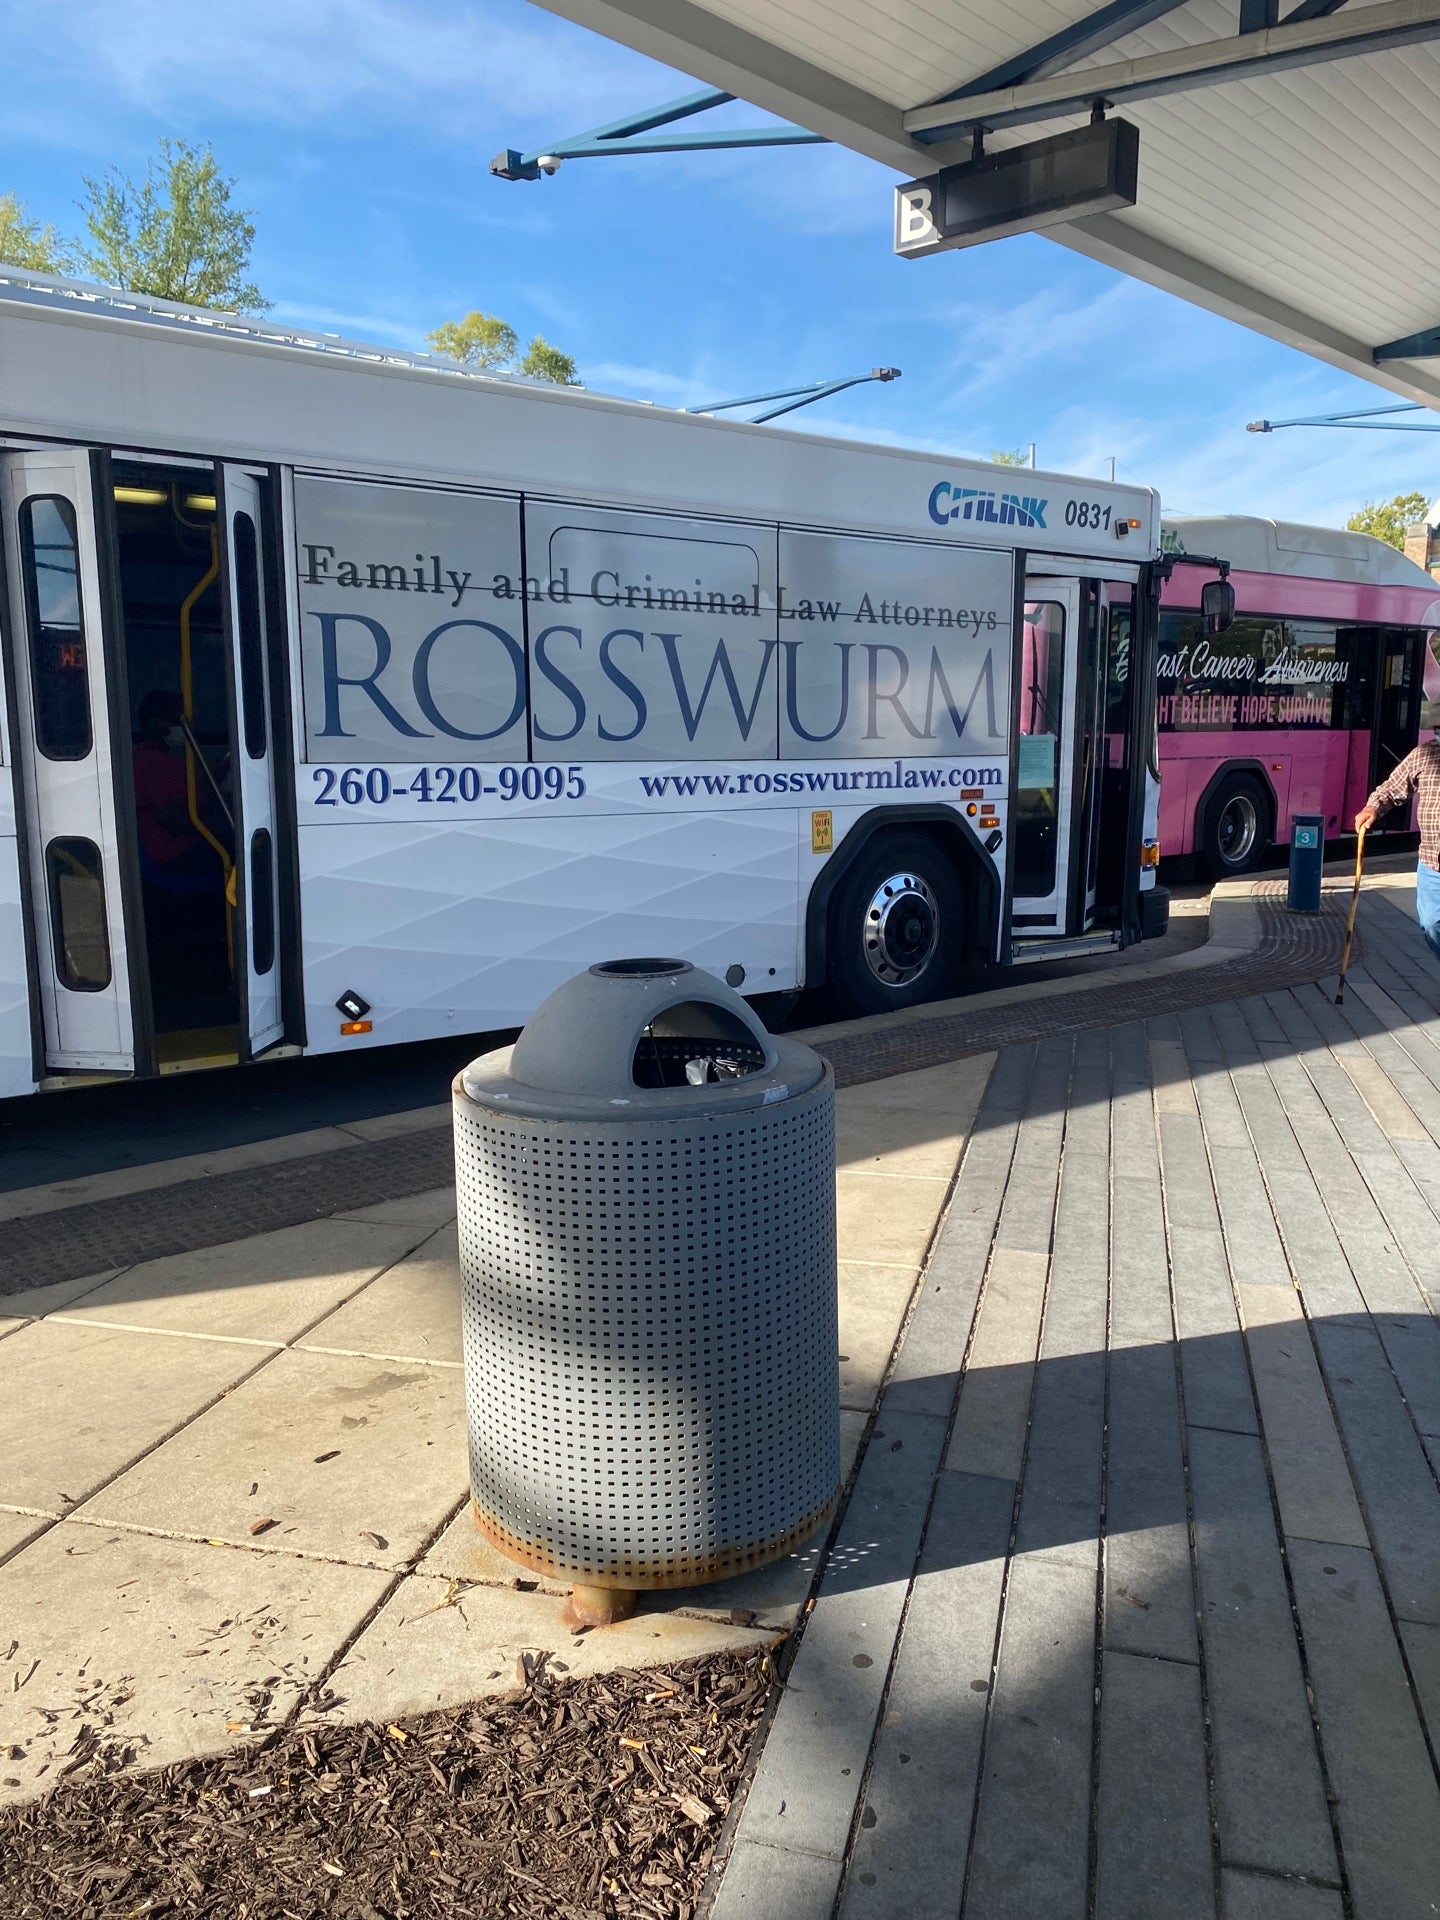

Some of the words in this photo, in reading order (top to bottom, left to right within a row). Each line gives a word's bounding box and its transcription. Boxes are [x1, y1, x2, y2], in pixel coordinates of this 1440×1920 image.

[900, 188, 934, 243] B
[928, 481, 1049, 529] CITILINK
[1064, 500, 1112, 531] 0831
[302, 543, 472, 607] Family
[492, 568, 573, 604] and
[590, 571, 762, 618] Criminal
[778, 587, 841, 623] Law
[854, 592, 997, 638] Attorneys
[306, 611, 1006, 742] ROSSWURM
[1190, 641, 1256, 680] Cancer
[1257, 646, 1350, 684] Awareness
[1181, 695, 1238, 725] BELIEVE
[1240, 695, 1274, 724] HOPE
[1278, 697, 1332, 724] SURVIVE
[312, 766, 586, 807] 260-420-9095
[640, 761, 1004, 797] www.rosswurmlaw.com
[1301, 832, 1310, 844] 3
